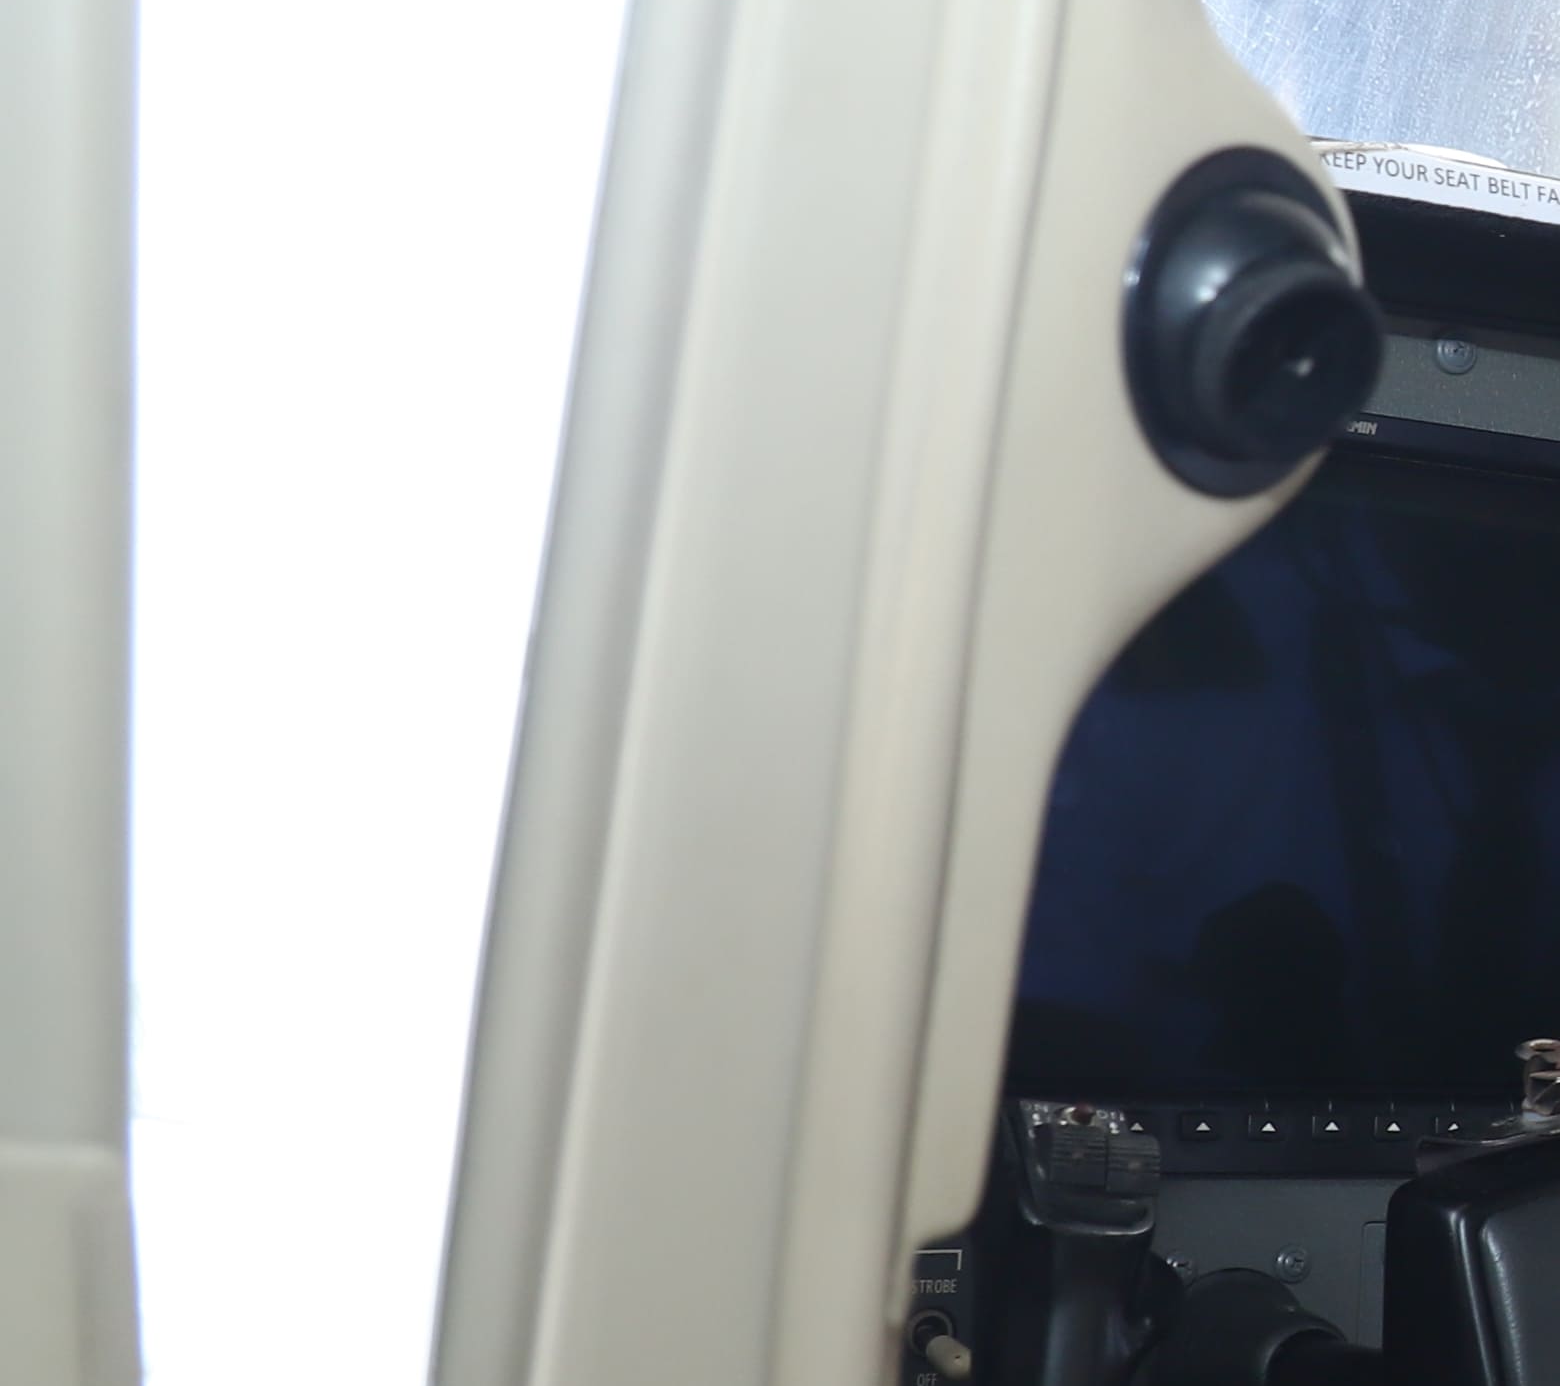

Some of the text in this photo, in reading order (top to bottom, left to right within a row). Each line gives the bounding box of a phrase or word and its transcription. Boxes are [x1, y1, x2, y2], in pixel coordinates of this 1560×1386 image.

[1373, 158, 1428, 184] YOUR
[1434, 169, 1481, 193] SEAT
[1488, 177, 1530, 201] BELT
